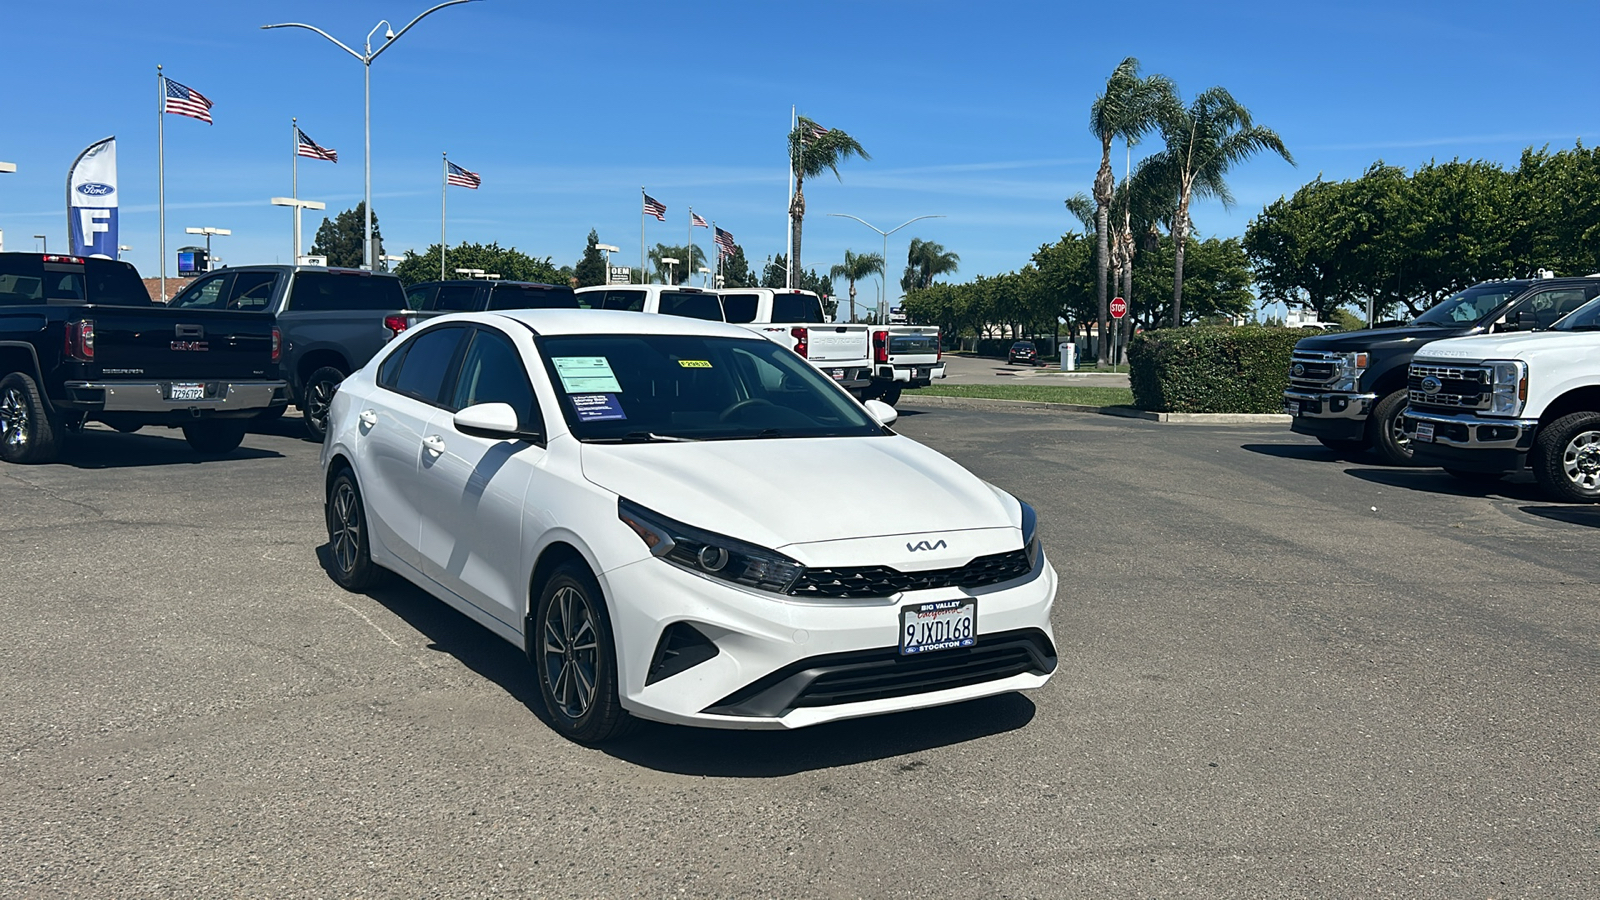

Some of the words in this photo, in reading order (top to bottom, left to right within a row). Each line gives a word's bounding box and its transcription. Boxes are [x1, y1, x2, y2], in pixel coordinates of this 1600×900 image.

[83, 184, 107, 195] Ford
[611, 267, 630, 275] OEM
[1111, 303, 1126, 312] STOP
[170, 341, 209, 351] GMC
[813, 337, 866, 345] CHEVROLET
[921, 603, 934, 611] BIG
[935, 600, 961, 609] VALLEY
[906, 617, 971, 647] 9JXD168
[919, 641, 960, 652] STOCKTON
